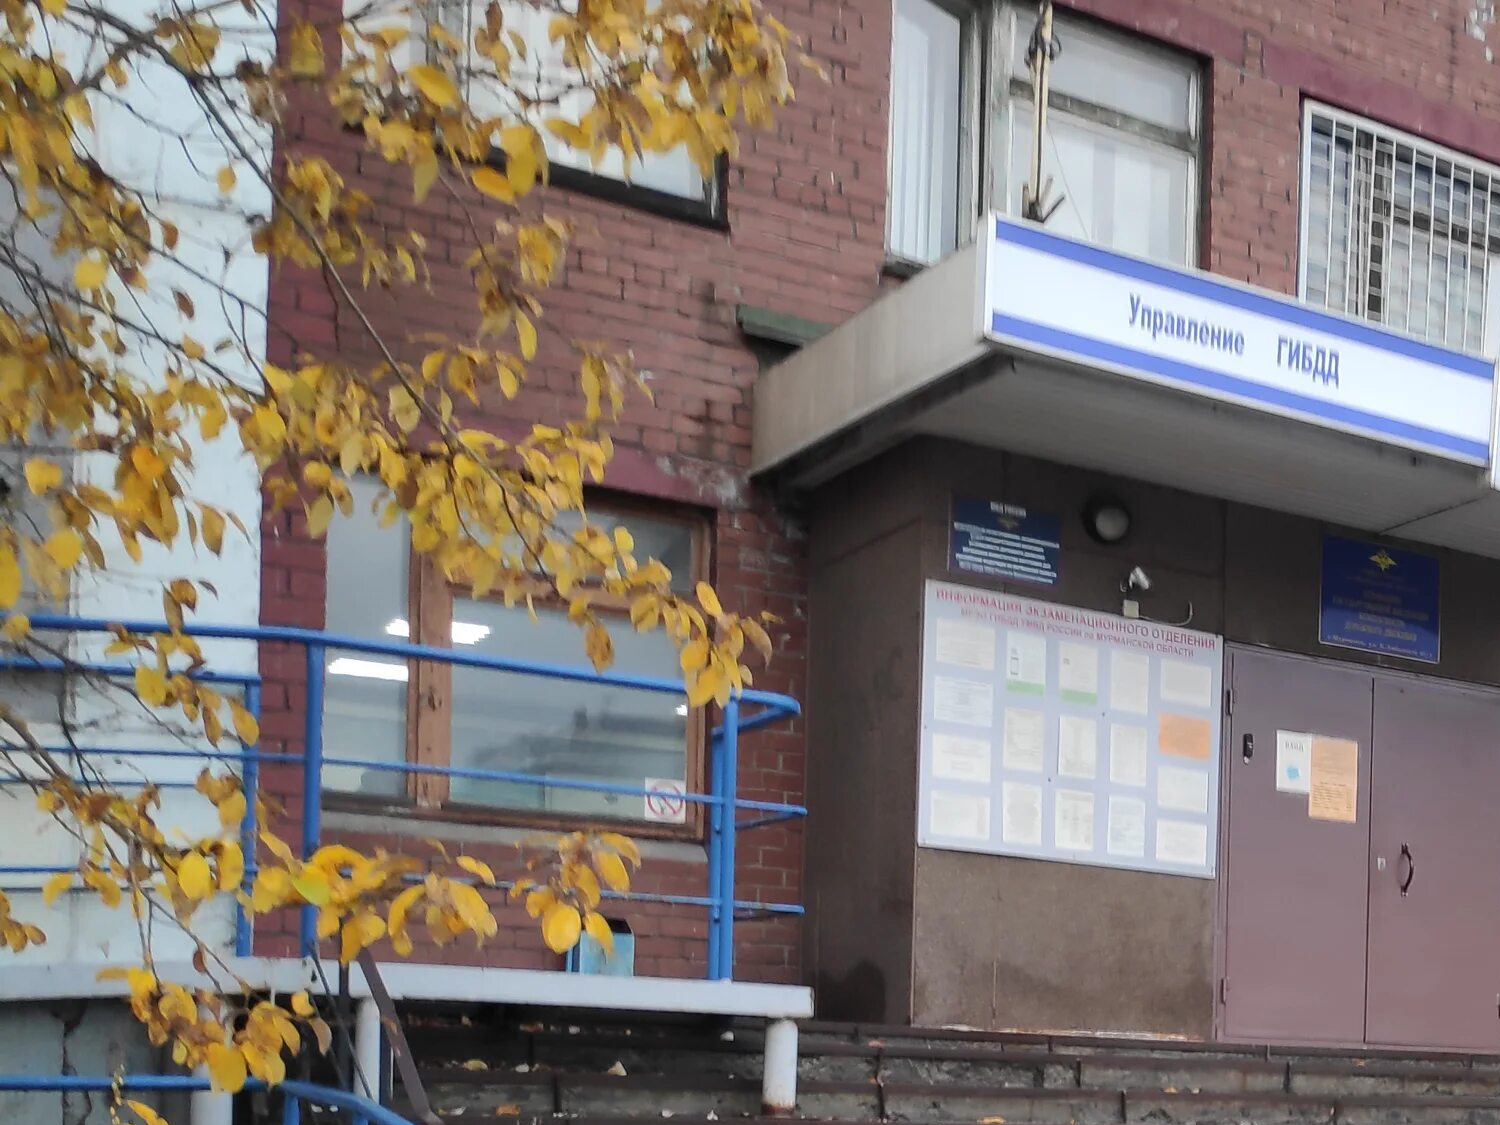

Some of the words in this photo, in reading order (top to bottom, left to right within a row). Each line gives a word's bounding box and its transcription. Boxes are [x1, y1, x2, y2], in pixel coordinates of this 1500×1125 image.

[1128, 292, 1246, 356] Управление
[1277, 335, 1341, 388] ГИБДД
[1151, 629, 1216, 651] ОТДЕЛЕНИЯ
